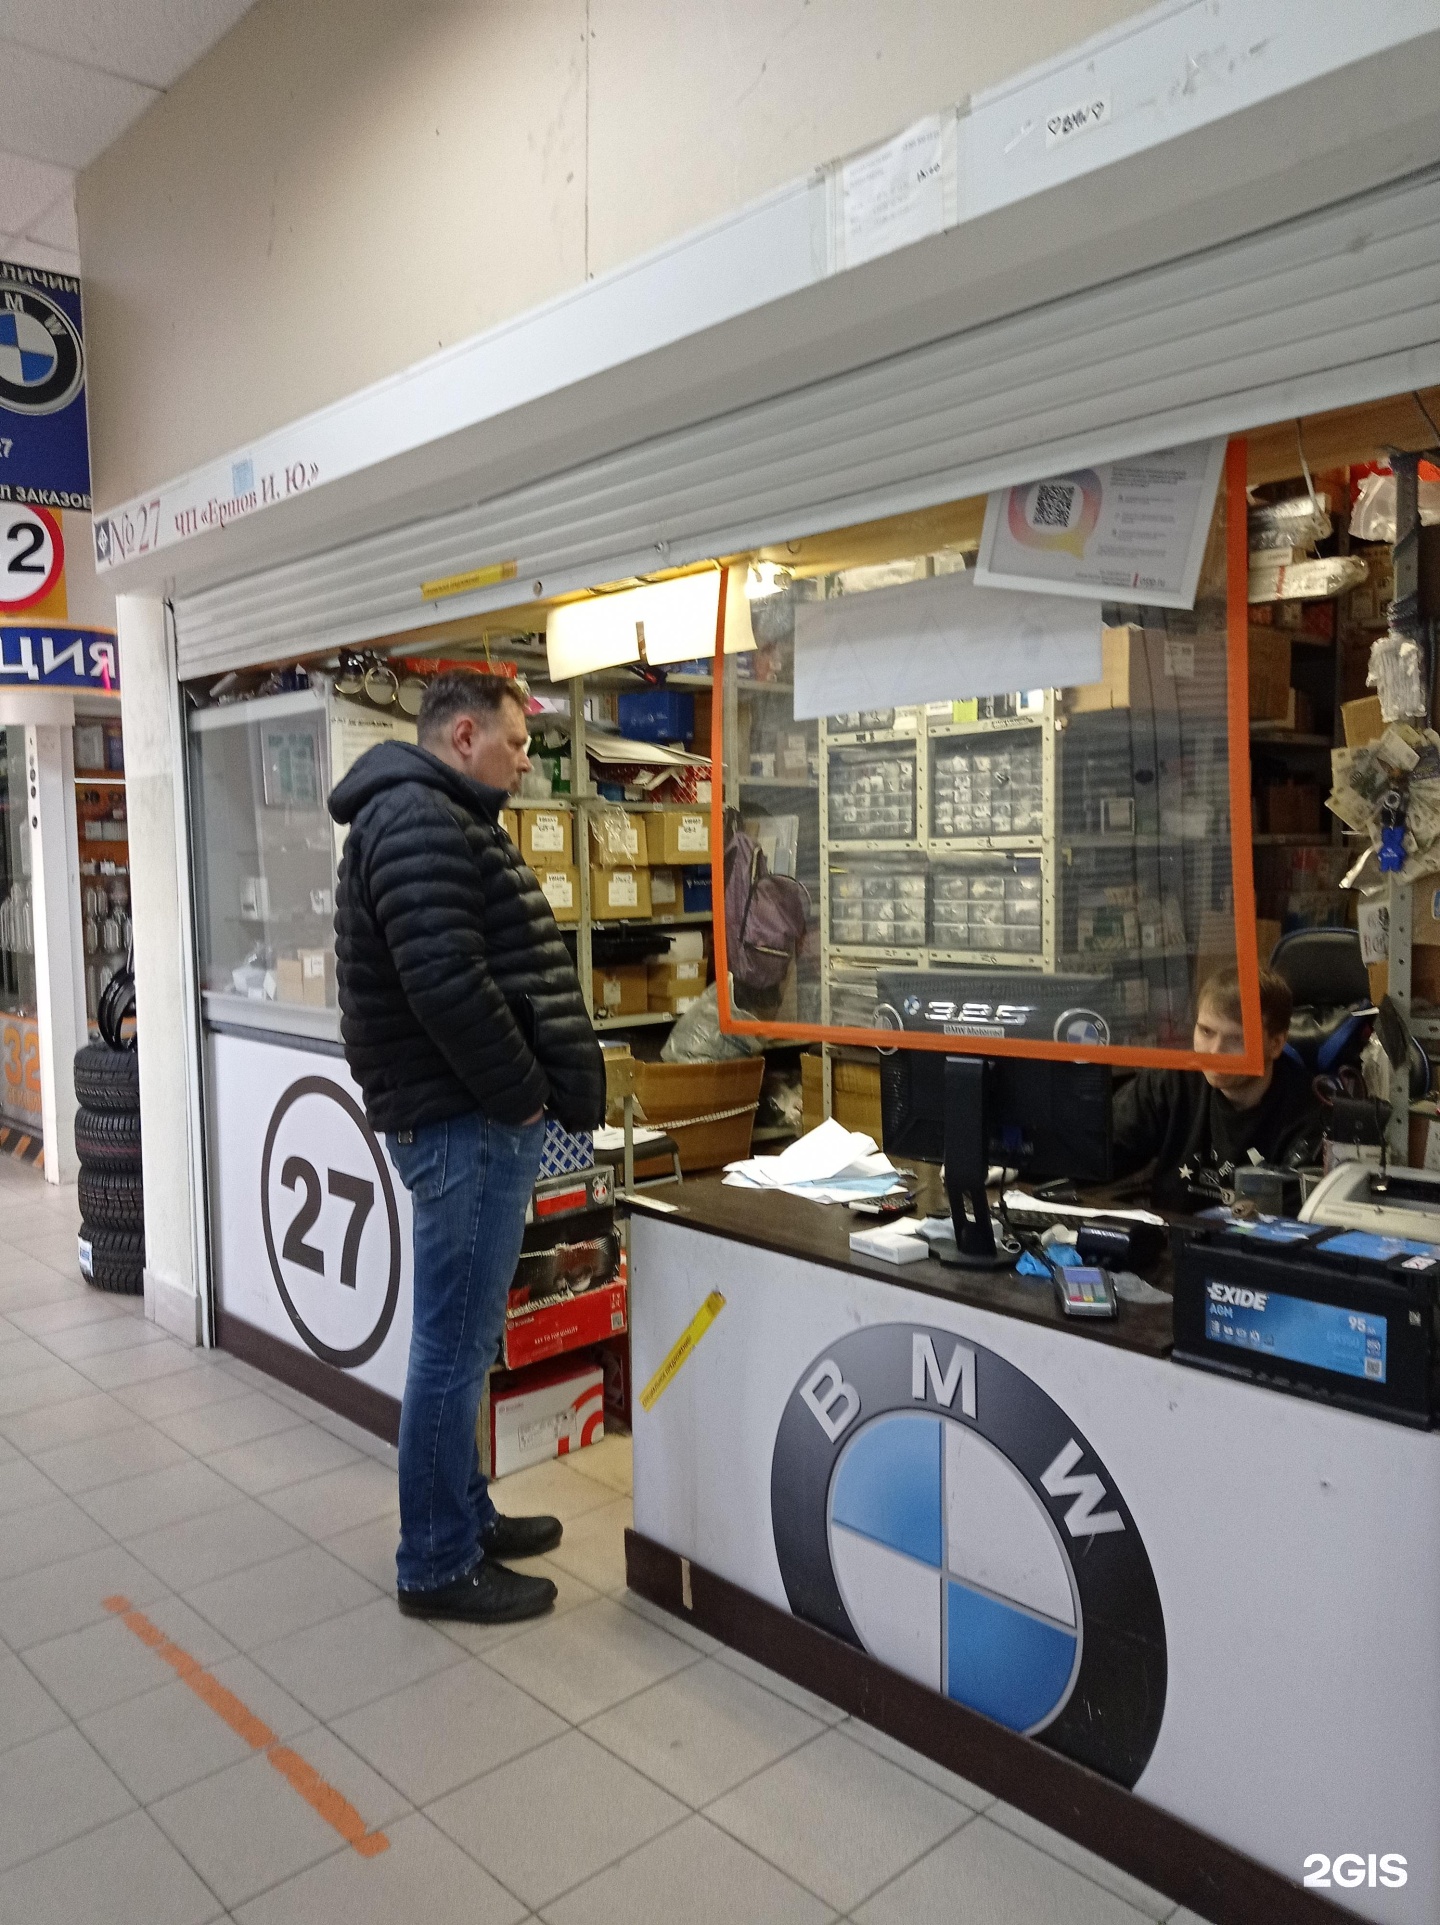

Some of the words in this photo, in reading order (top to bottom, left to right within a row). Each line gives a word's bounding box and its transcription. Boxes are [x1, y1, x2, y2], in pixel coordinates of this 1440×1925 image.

[0, 263, 79, 294] ЛИЧИИ
[281, 1156, 374, 1290] 27
[1207, 1282, 1268, 1312] EXIDE
[1348, 1315, 1366, 1333] 95
[800, 1331, 1126, 1538] BMW
